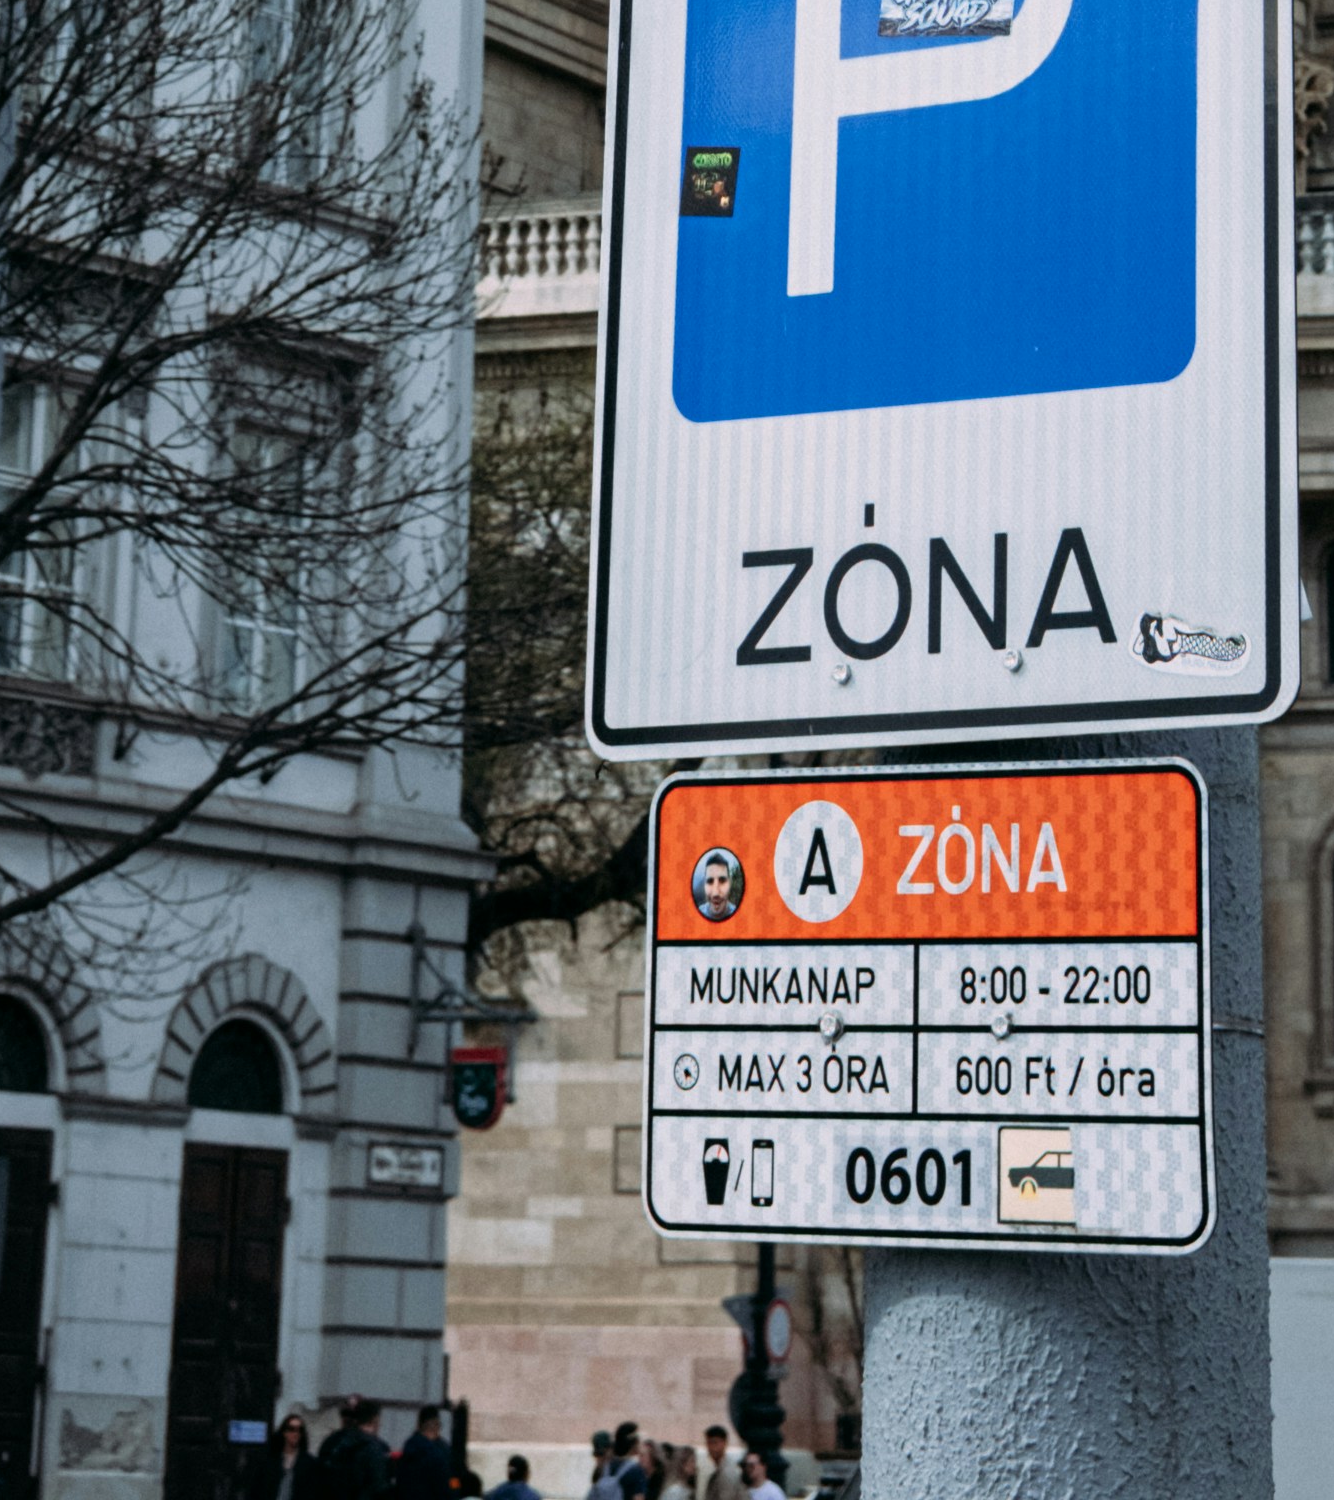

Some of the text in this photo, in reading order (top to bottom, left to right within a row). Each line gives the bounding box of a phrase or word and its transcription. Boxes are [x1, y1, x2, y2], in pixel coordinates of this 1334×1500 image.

[735, 503, 1118, 666] ZÓNA
[798, 805, 1068, 895] A ZÓNA
[689, 967, 876, 1004] MUNKANAP
[960, 966, 1027, 1004] 8:00
[1063, 965, 1151, 1004] 22:00
[717, 1045, 890, 1094] MAX 3 ÓRA
[955, 1056, 1156, 1098] 600 Ft / óra
[845, 1147, 973, 1206] 0601
